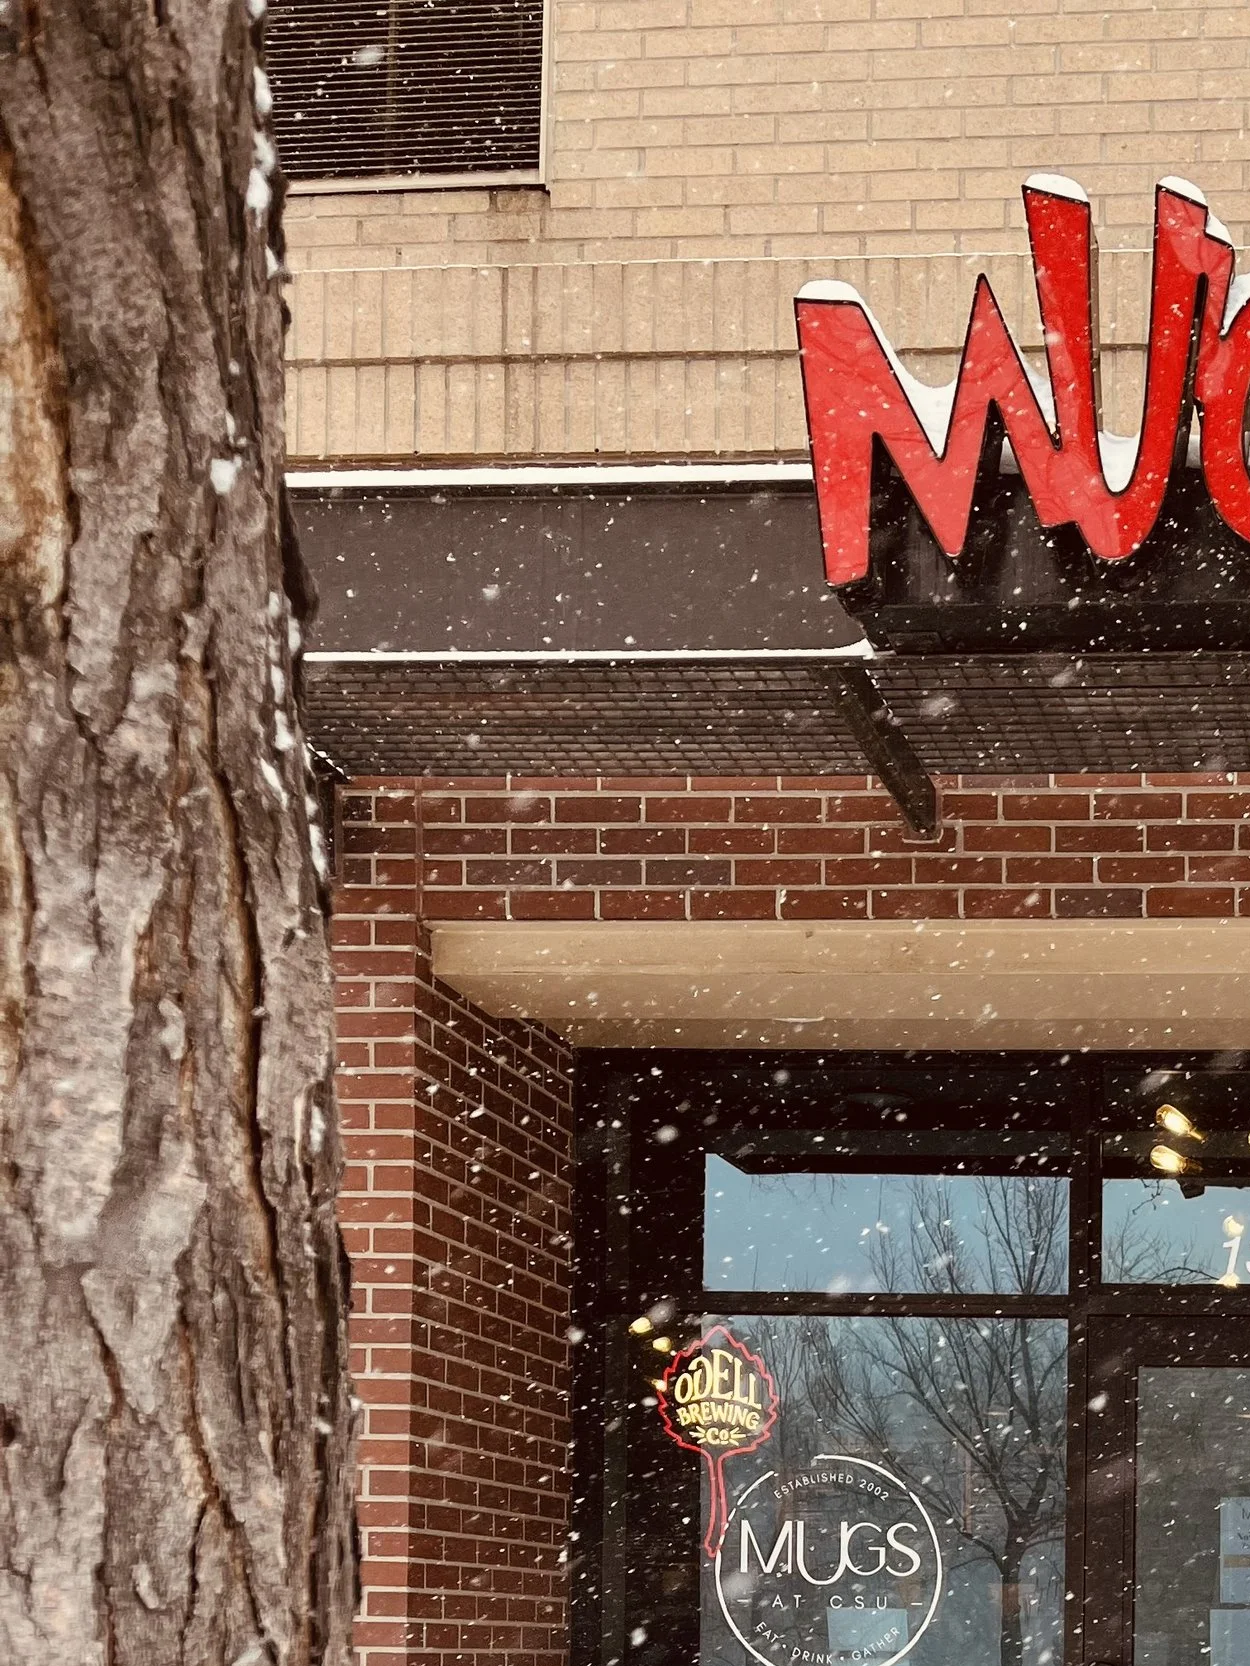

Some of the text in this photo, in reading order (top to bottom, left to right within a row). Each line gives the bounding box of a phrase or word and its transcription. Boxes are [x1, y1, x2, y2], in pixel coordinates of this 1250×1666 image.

[674, 1349, 762, 1410] ODELL
[676, 1401, 760, 1430] BREWING
[774, 1473, 889, 1501] ESTABLISHED 2002
[739, 1519, 921, 1586] MUGS
[771, 1594, 888, 1610] AT CSU
[754, 1621, 901, 1665] EAT DRINK GATHER
